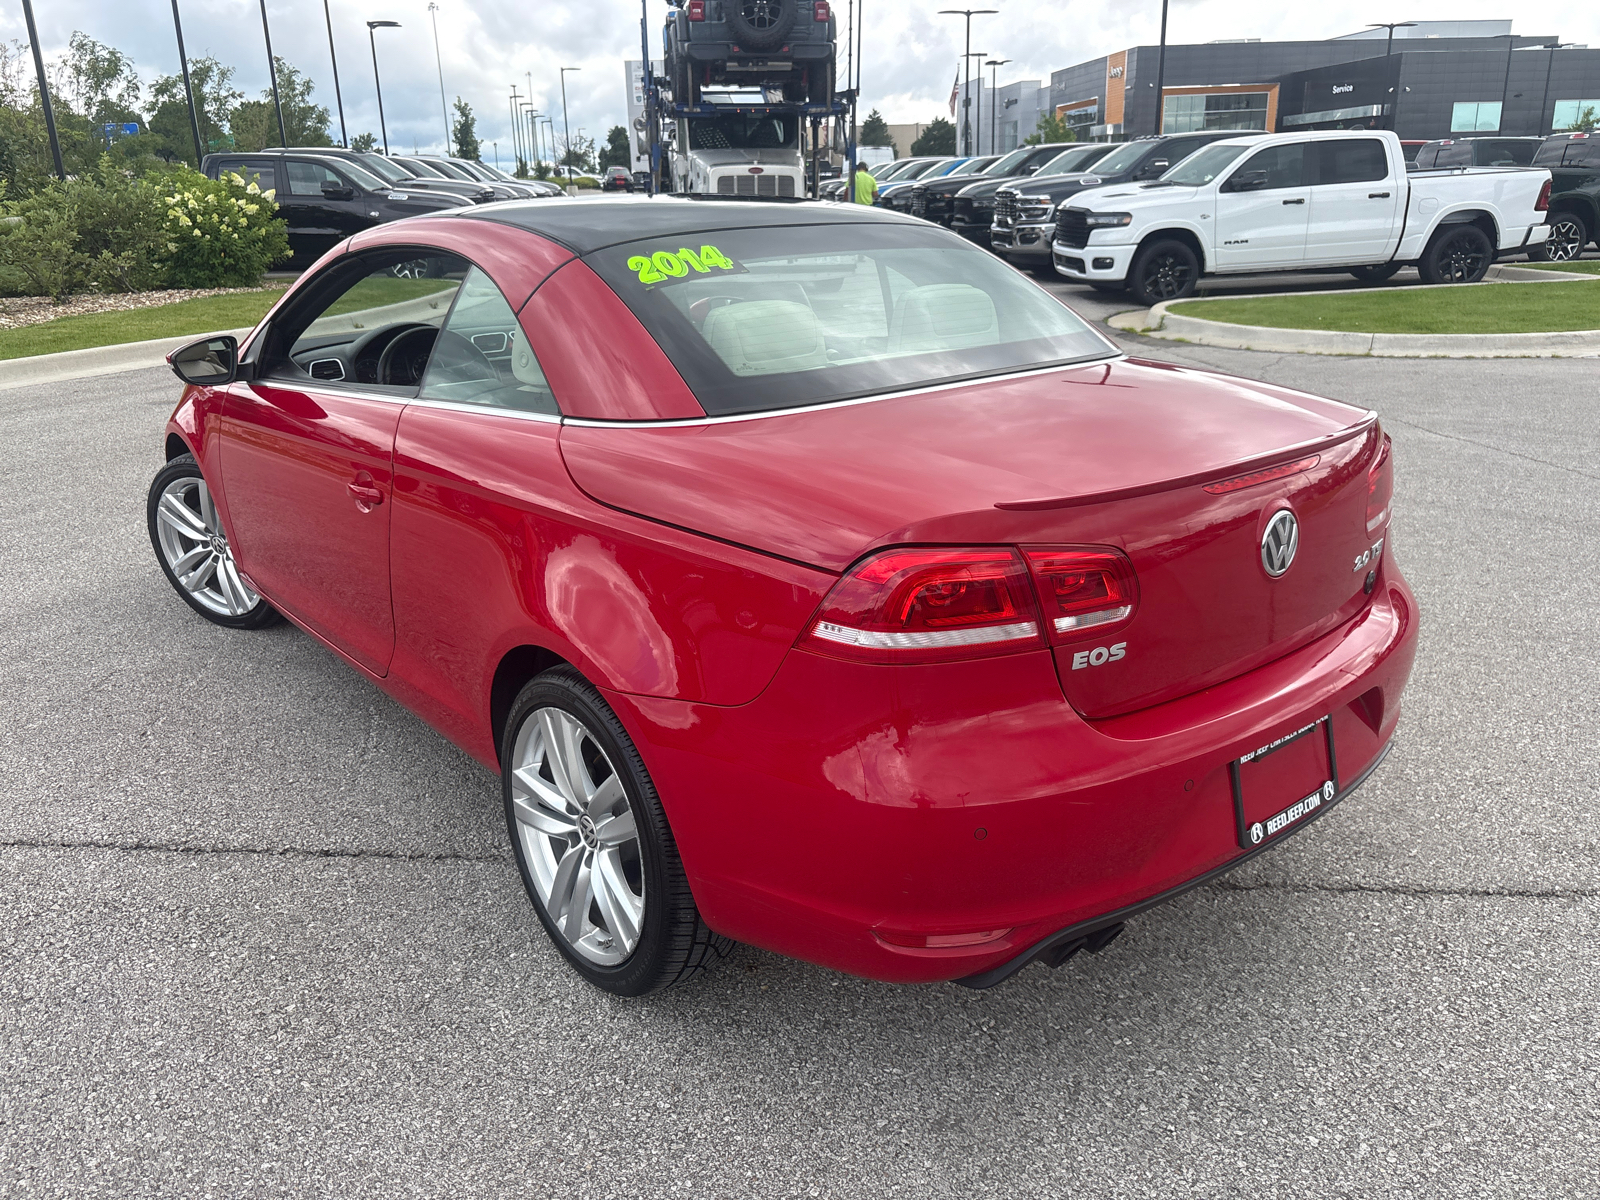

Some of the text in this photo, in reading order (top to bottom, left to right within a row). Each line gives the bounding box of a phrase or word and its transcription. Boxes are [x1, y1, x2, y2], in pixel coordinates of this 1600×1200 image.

[1332, 84, 1353, 95] Service
[627, 245, 734, 284] 2014
[1072, 641, 1127, 670] EOS
[1266, 792, 1321, 836] REEDJEEP.COM
